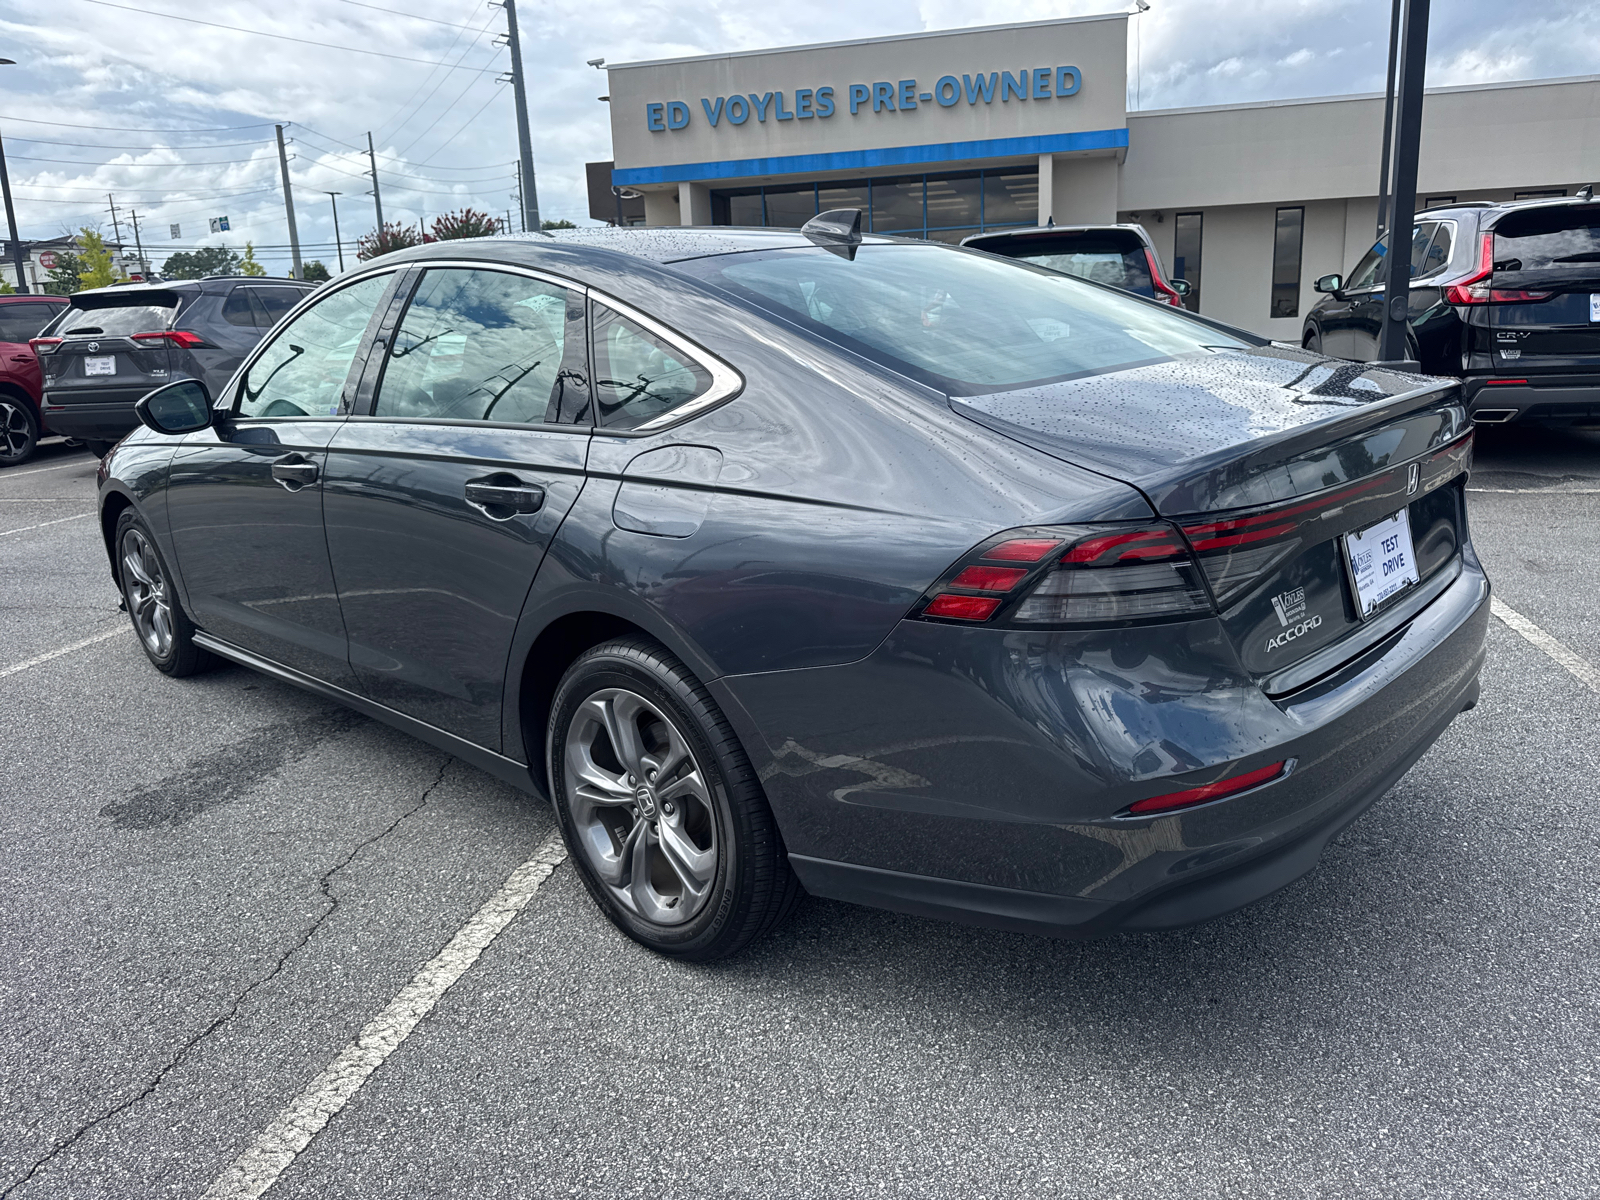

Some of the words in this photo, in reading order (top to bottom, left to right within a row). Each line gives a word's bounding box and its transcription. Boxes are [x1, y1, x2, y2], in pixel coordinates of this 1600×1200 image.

[646, 101, 690, 131] ED
[701, 86, 835, 127] VOYLES
[849, 65, 1082, 115] PRE-OWNED
[1381, 534, 1399, 555] TEST
[1382, 552, 1405, 577] DRIVE
[1278, 589, 1305, 612] VOYLES
[1266, 614, 1322, 653] ACCORD
[711, 888, 732, 933] ENERGY
